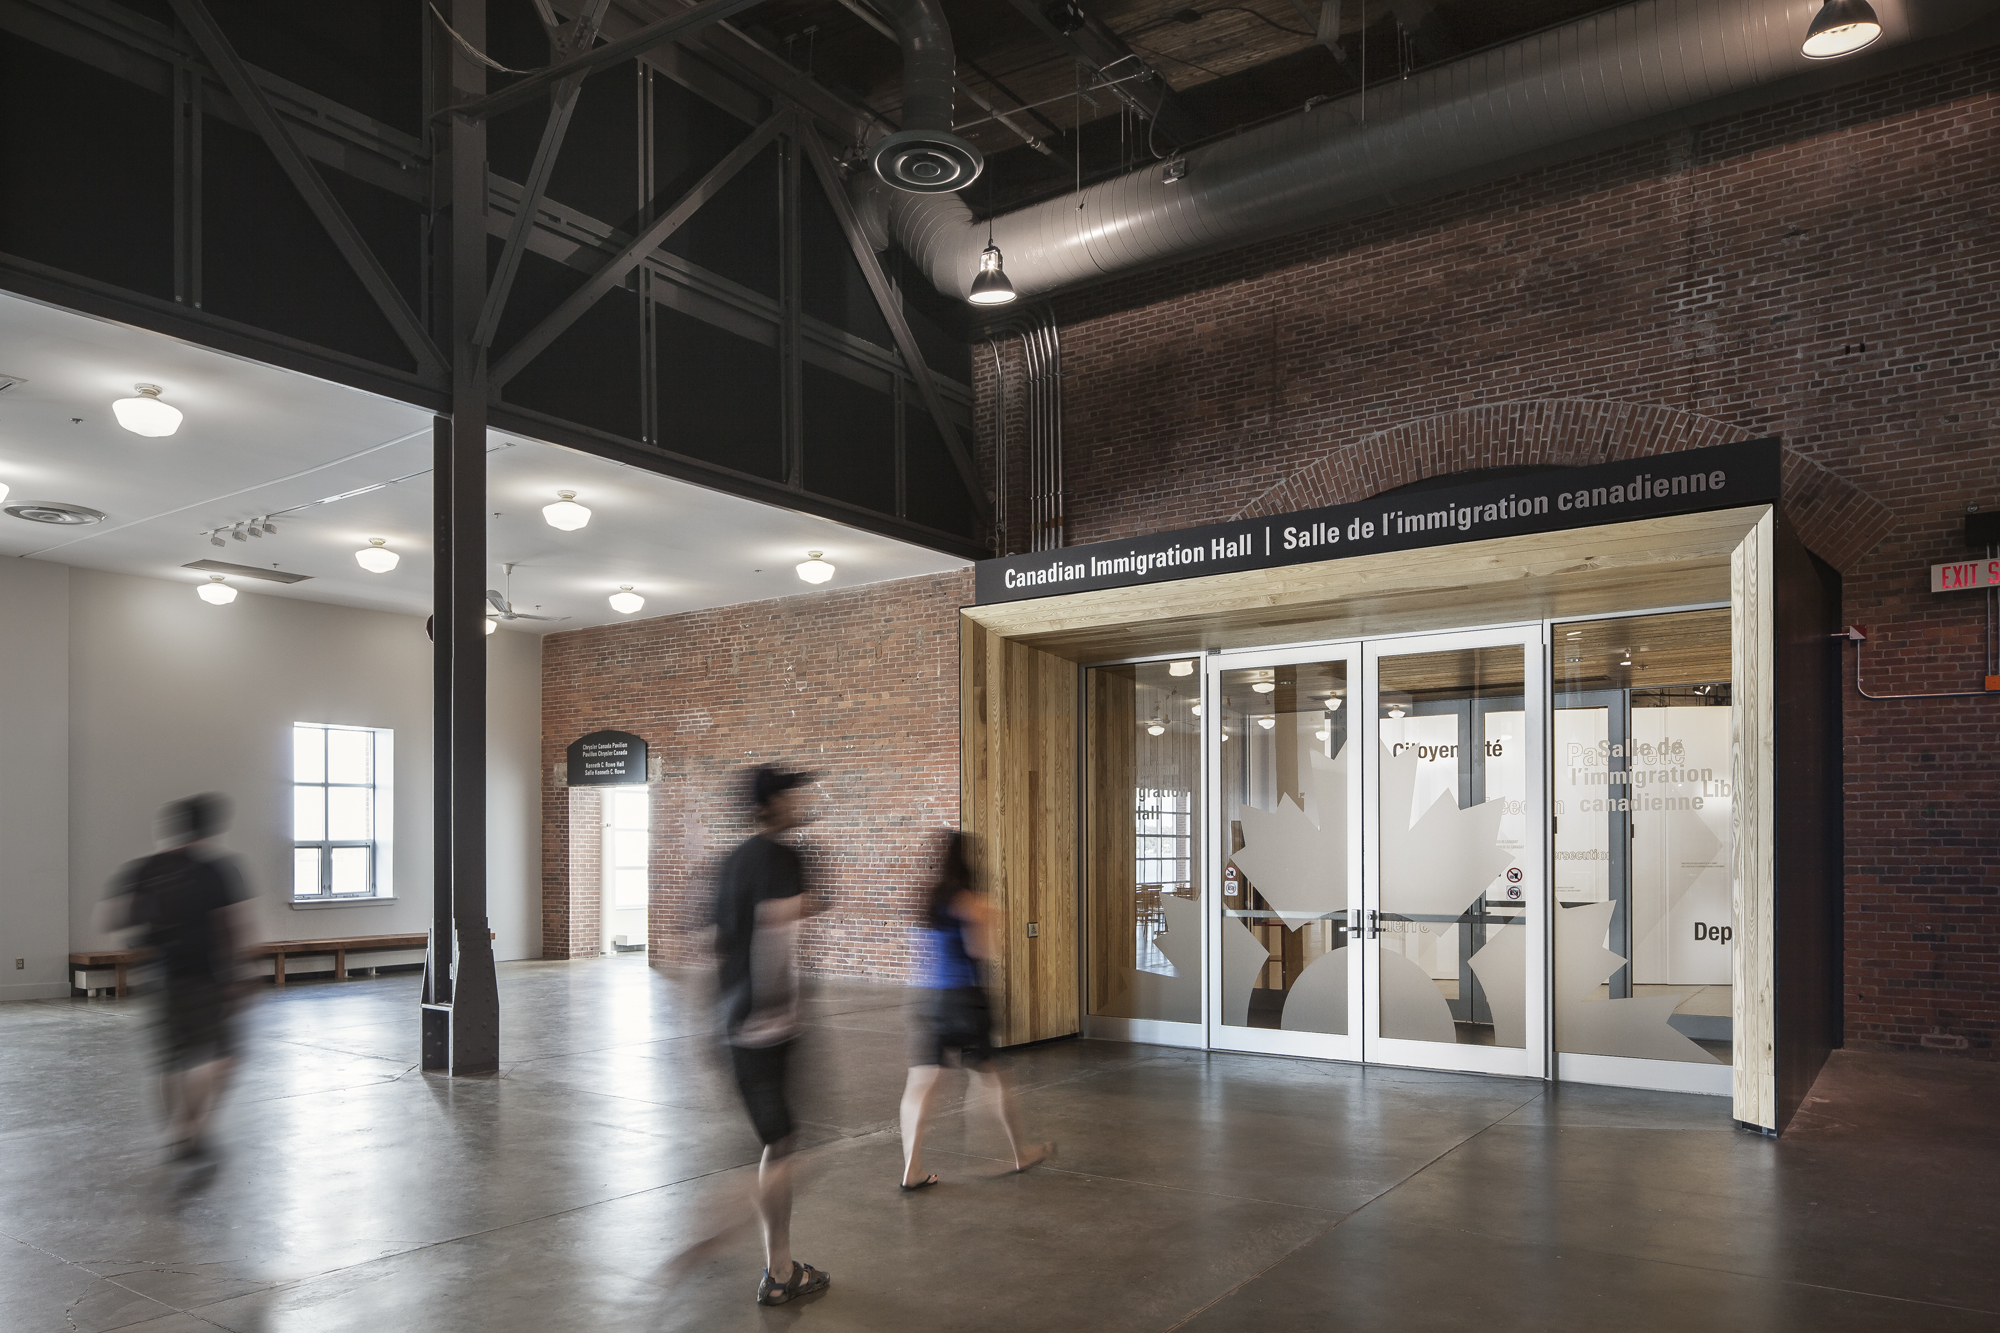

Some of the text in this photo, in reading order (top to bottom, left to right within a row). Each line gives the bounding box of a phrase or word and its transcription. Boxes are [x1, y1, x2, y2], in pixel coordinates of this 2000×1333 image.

[1283, 470, 1726, 550] Salle de l'immigration canadienne
[1004, 533, 1252, 589] Canadian Immigration Hall
[1942, 563, 1979, 588] EXIT
[1598, 736, 1683, 758] Salle de
[1571, 764, 1713, 789] l'immigration
[1580, 792, 1704, 812] canadienne
